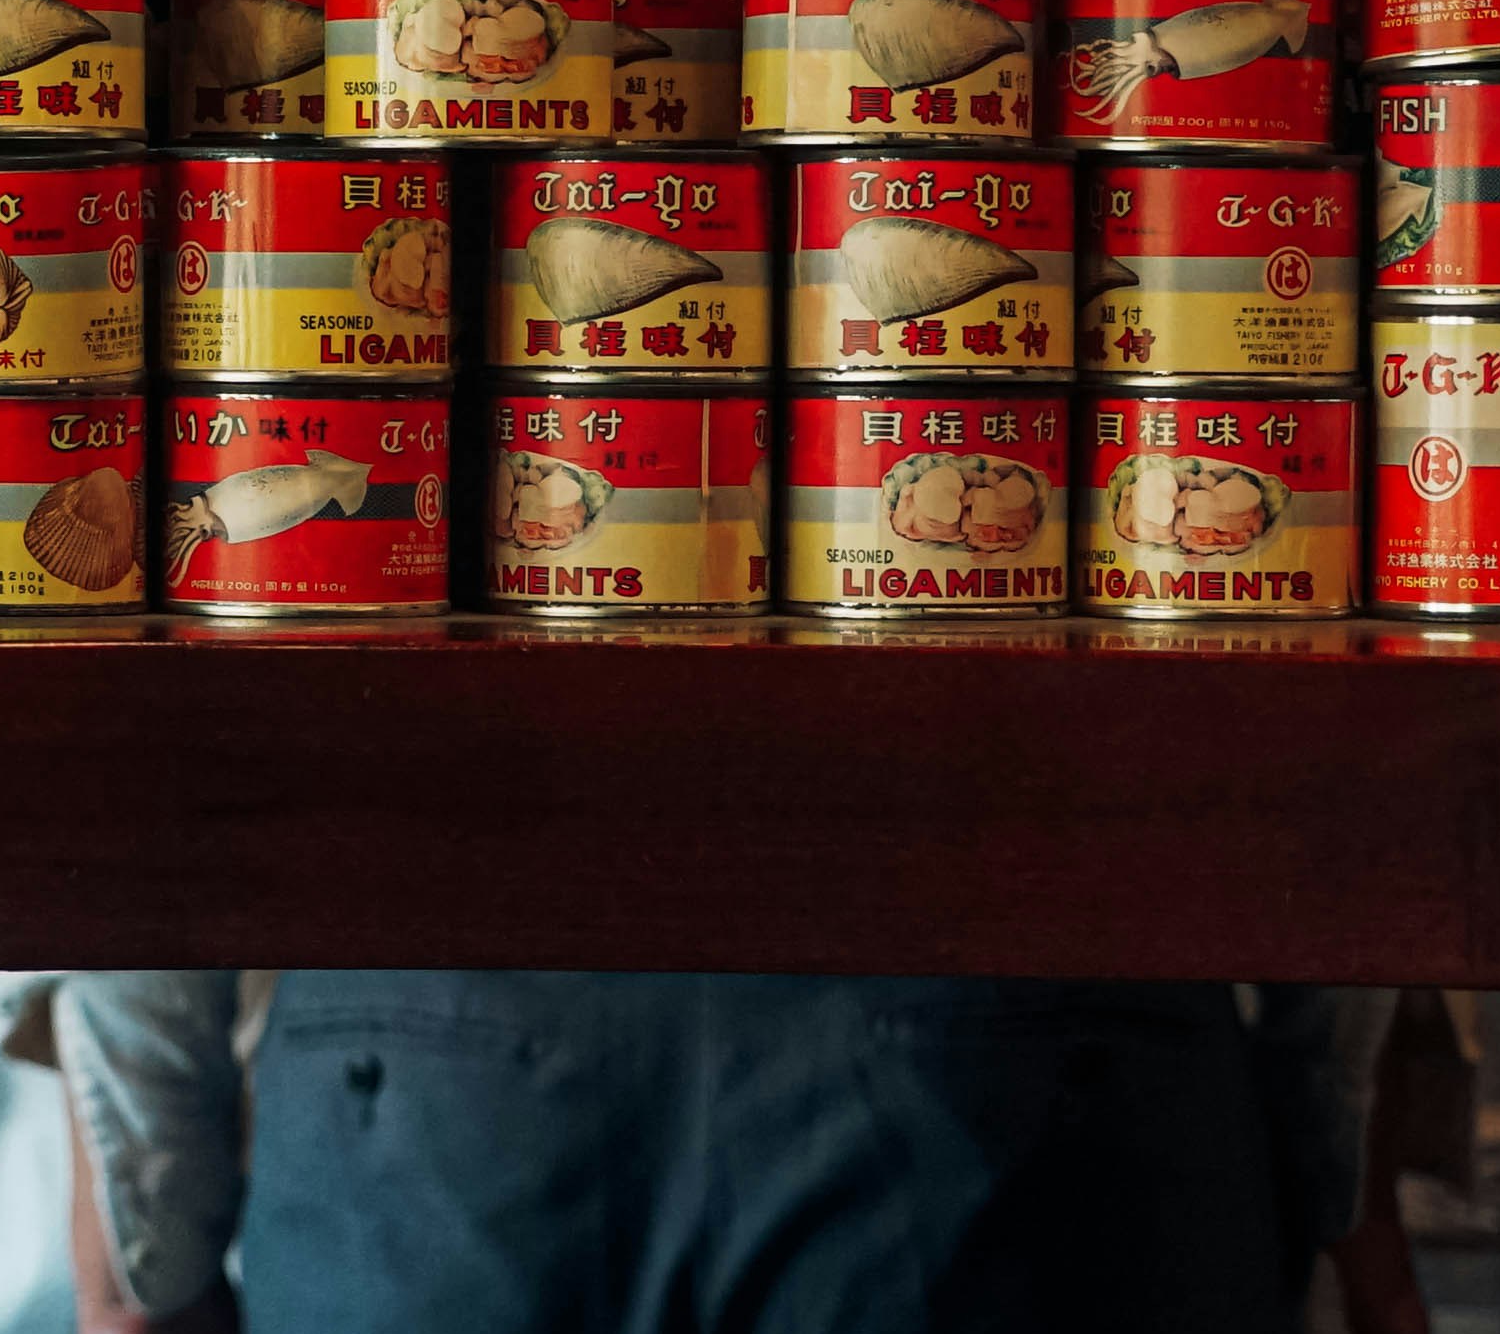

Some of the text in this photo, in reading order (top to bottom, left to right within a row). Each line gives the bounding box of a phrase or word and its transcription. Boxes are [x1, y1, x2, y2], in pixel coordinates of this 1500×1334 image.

[1404, 15, 1449, 25] FISHERY
[343, 80, 398, 98] SEASONED
[354, 99, 591, 133] LIGAMENTS
[849, 87, 1031, 126] 貝柱味付
[1379, 97, 1447, 135] FISH
[300, 314, 374, 332] SEASONED
[524, 320, 738, 359] 貝柱味付
[839, 320, 1048, 359] 貝柱味付
[861, 408, 1058, 446] 貝柱味付
[1097, 411, 1299, 448] 貝柱味付
[825, 547, 894, 566] SEASONED
[8, 569, 46, 584] 210g
[8, 583, 46, 597] 150g
[840, 567, 1063, 598] LIGAMENTS
[1084, 570, 1314, 603] LIGAMENTS
[1396, 576, 1448, 589] FISHERY
